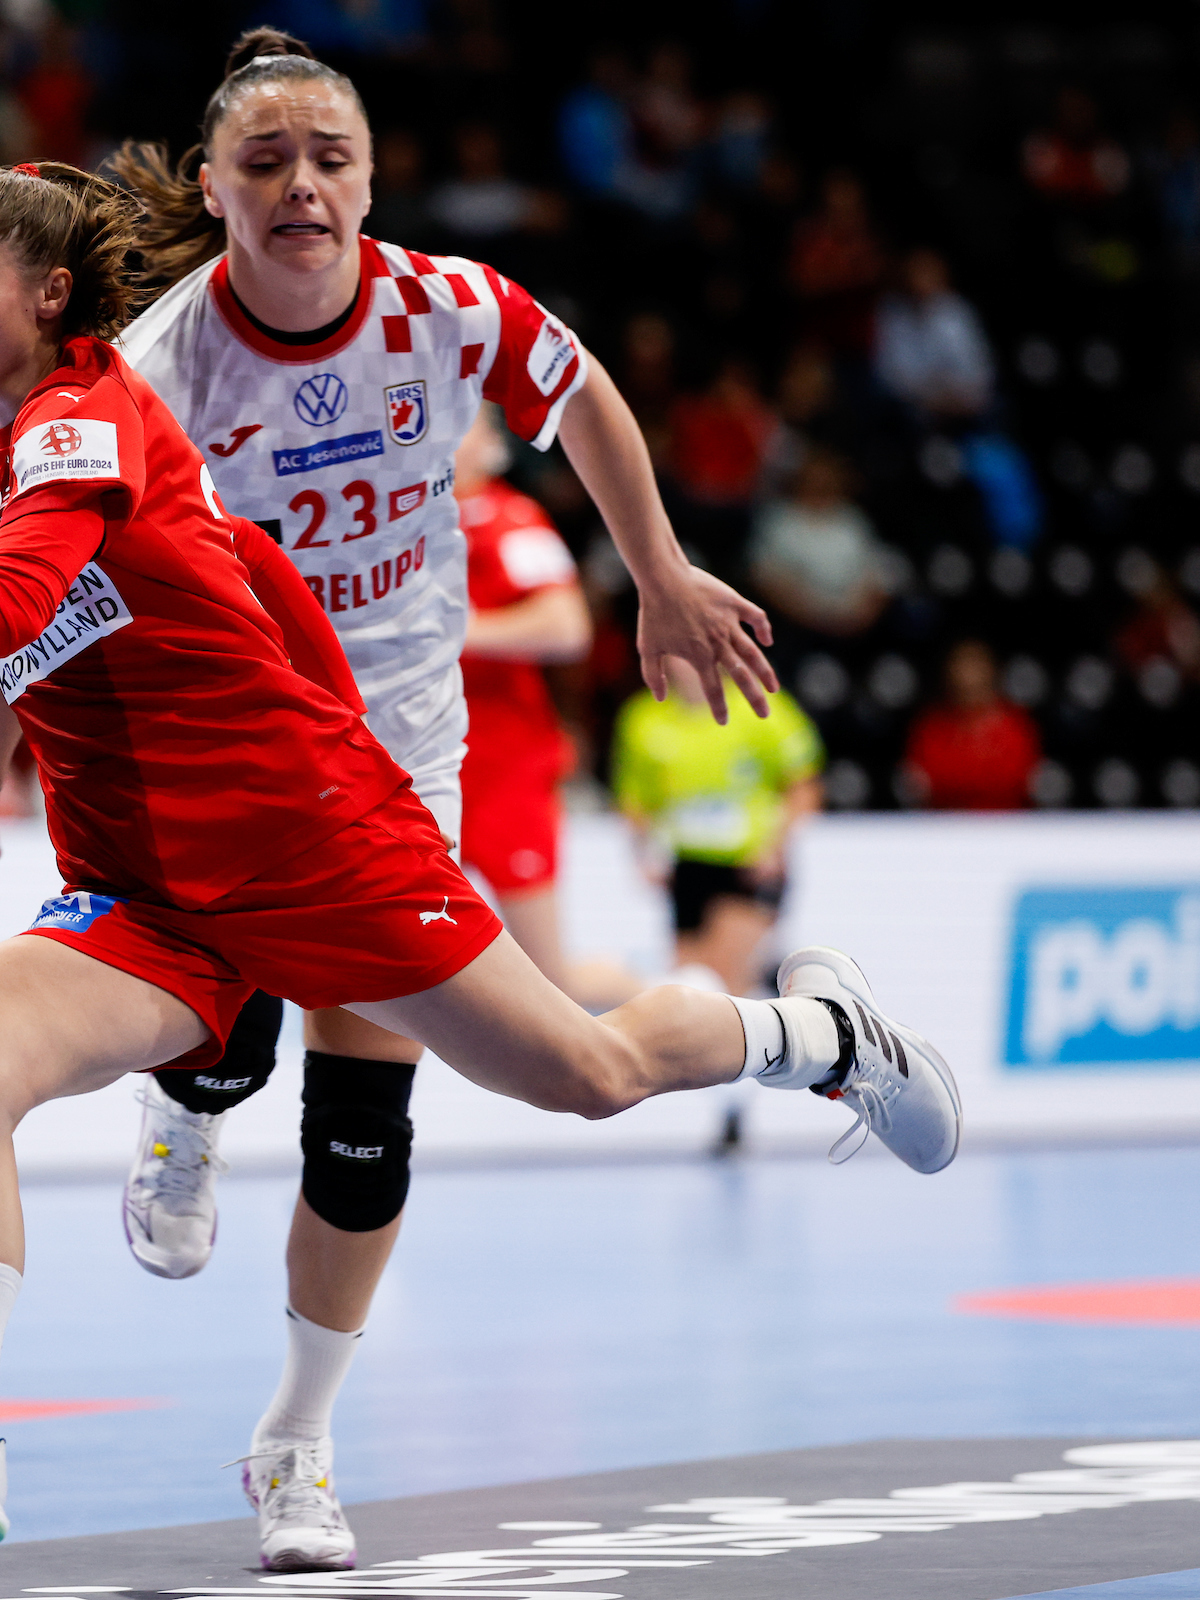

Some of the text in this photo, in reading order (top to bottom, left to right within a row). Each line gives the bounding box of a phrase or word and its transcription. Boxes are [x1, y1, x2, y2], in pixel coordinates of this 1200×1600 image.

[388, 385, 423, 402] HRS
[278, 436, 382, 470] AC Jesenović
[50, 461, 65, 470] EHF
[67, 459, 89, 469] EURO
[90, 460, 112, 470] 2024
[288, 480, 377, 550] 23
[303, 535, 426, 613] BELUPO
[193, 1074, 253, 1091] SELECT
[329, 1140, 384, 1160] SELECT
